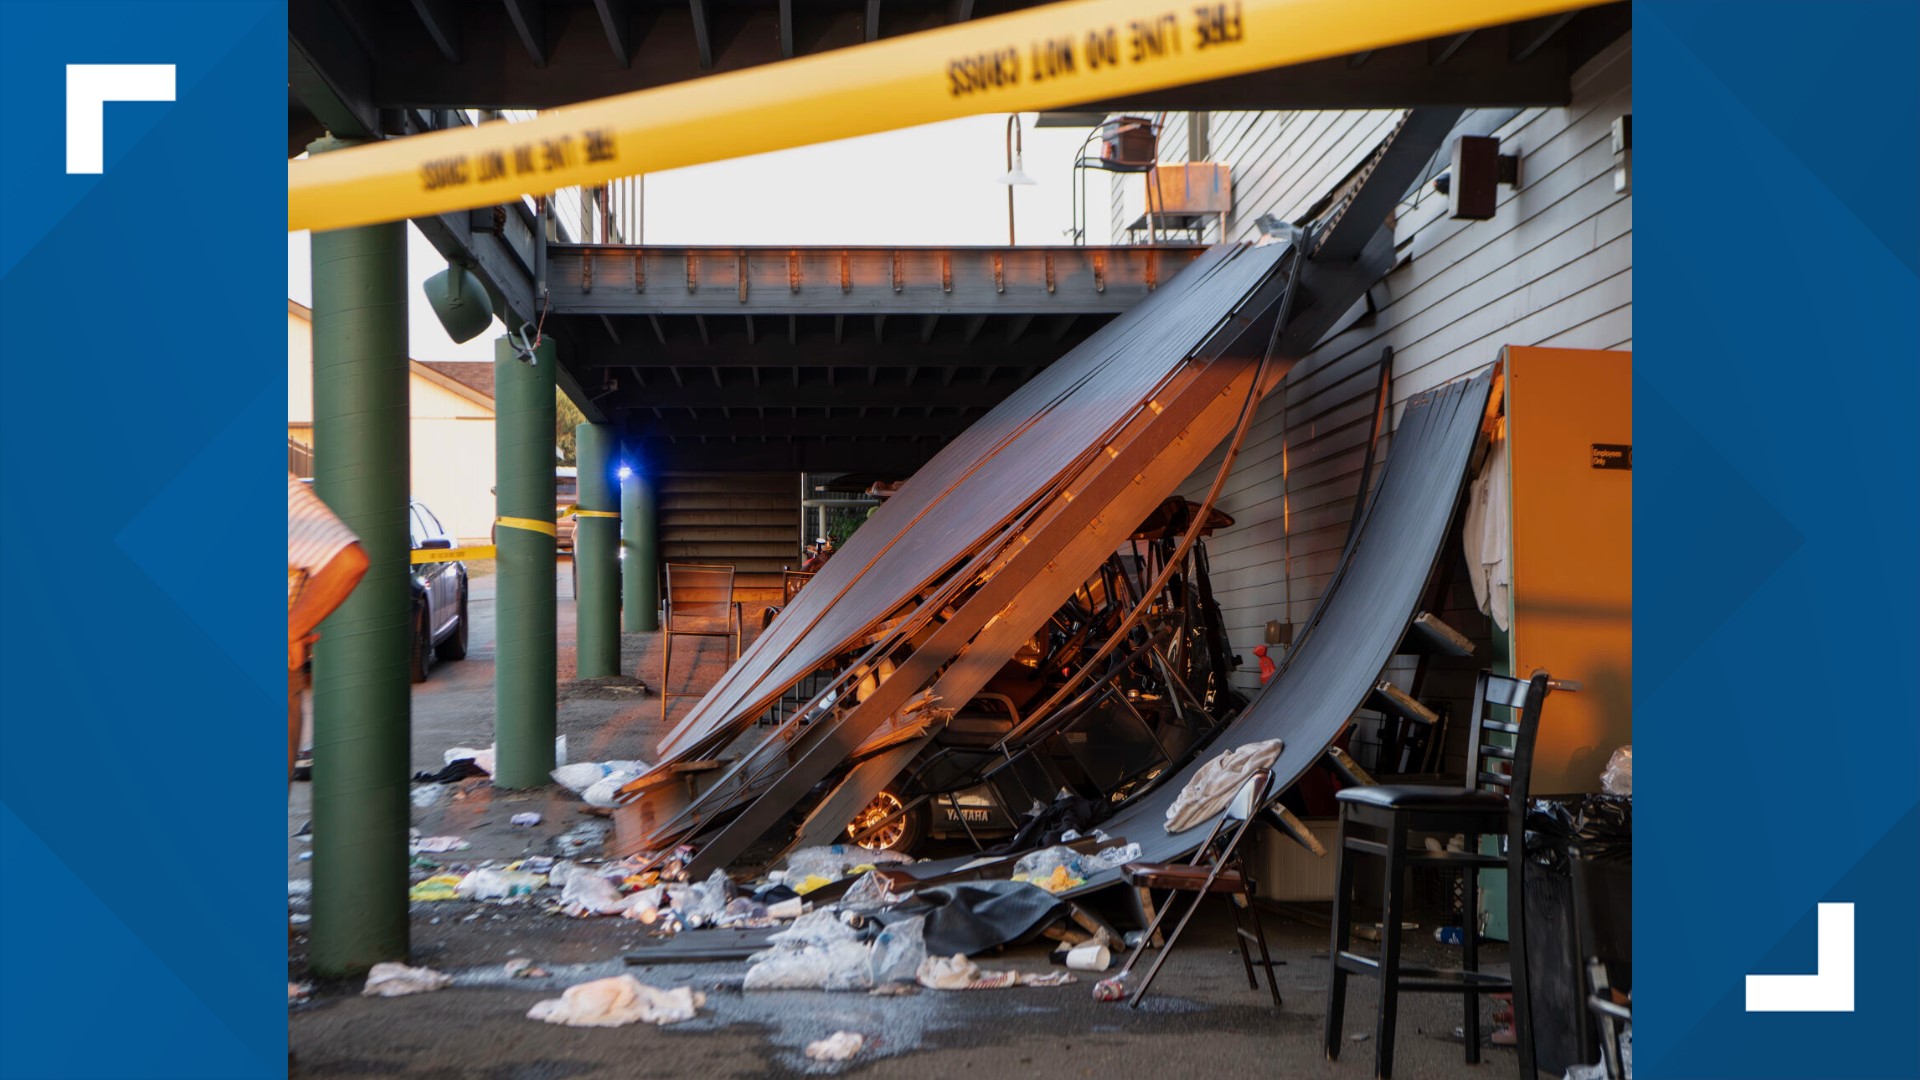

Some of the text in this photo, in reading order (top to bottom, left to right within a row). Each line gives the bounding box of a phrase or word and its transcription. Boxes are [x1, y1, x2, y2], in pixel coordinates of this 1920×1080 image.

[947, 2, 1243, 97] FIRE LINE DO NOT CROSS
[1593, 449, 1622, 458] Employees
[1593, 457, 1606, 466] Only
[945, 808, 989, 821] YAMAHA
